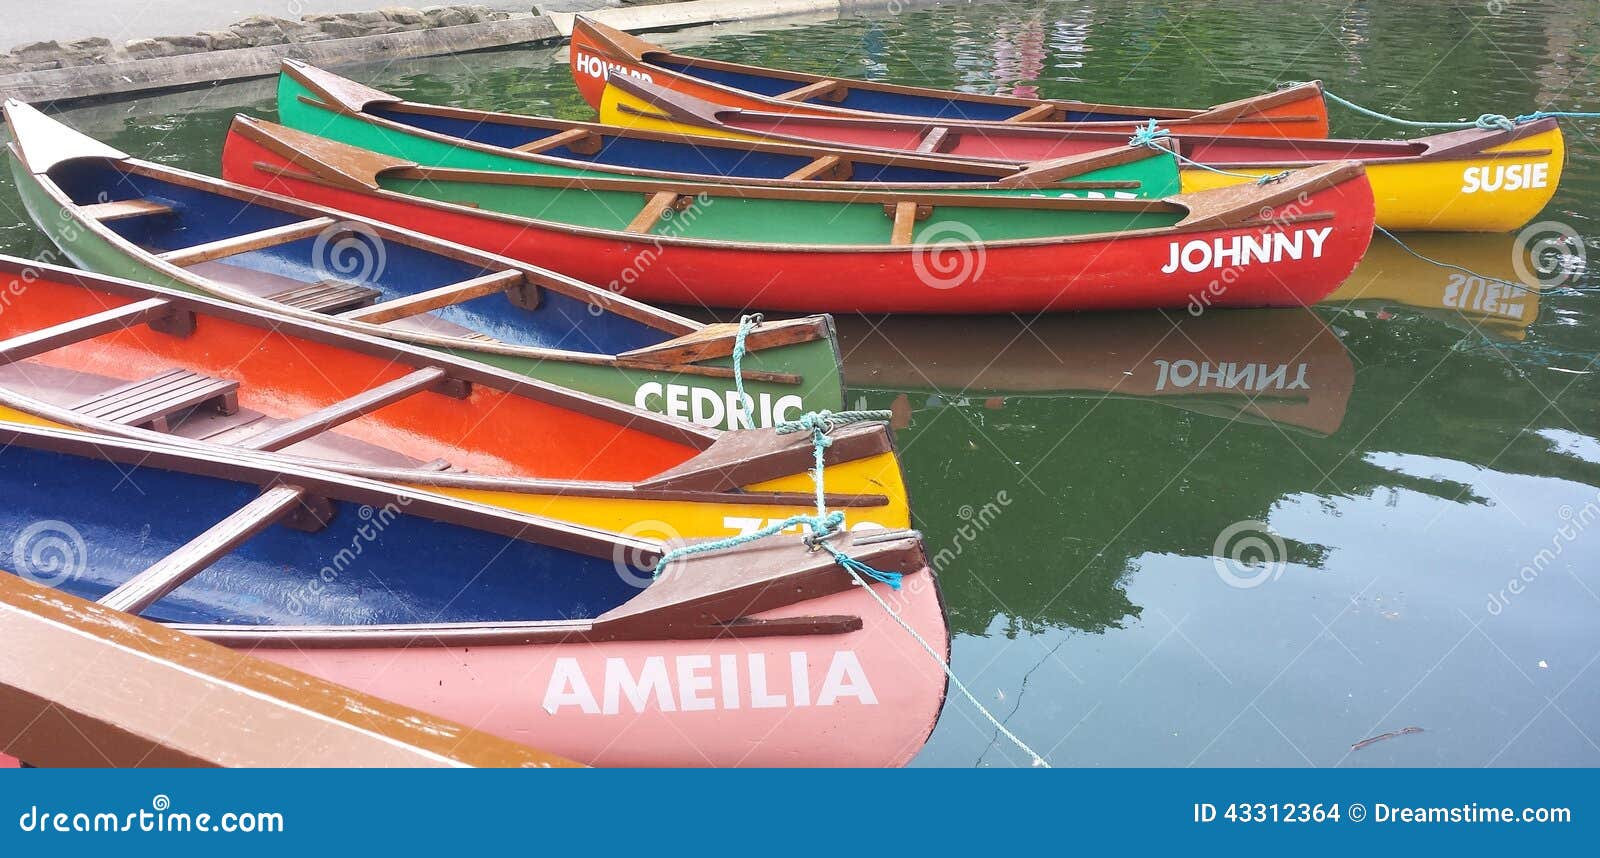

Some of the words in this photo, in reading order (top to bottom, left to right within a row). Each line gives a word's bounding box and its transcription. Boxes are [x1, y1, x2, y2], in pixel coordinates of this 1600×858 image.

[1461, 162, 1549, 194] SUSIE
[1161, 226, 1333, 274] JOHNNY
[634, 381, 803, 430] CEDRIC
[542, 651, 879, 715] AMEILIA
